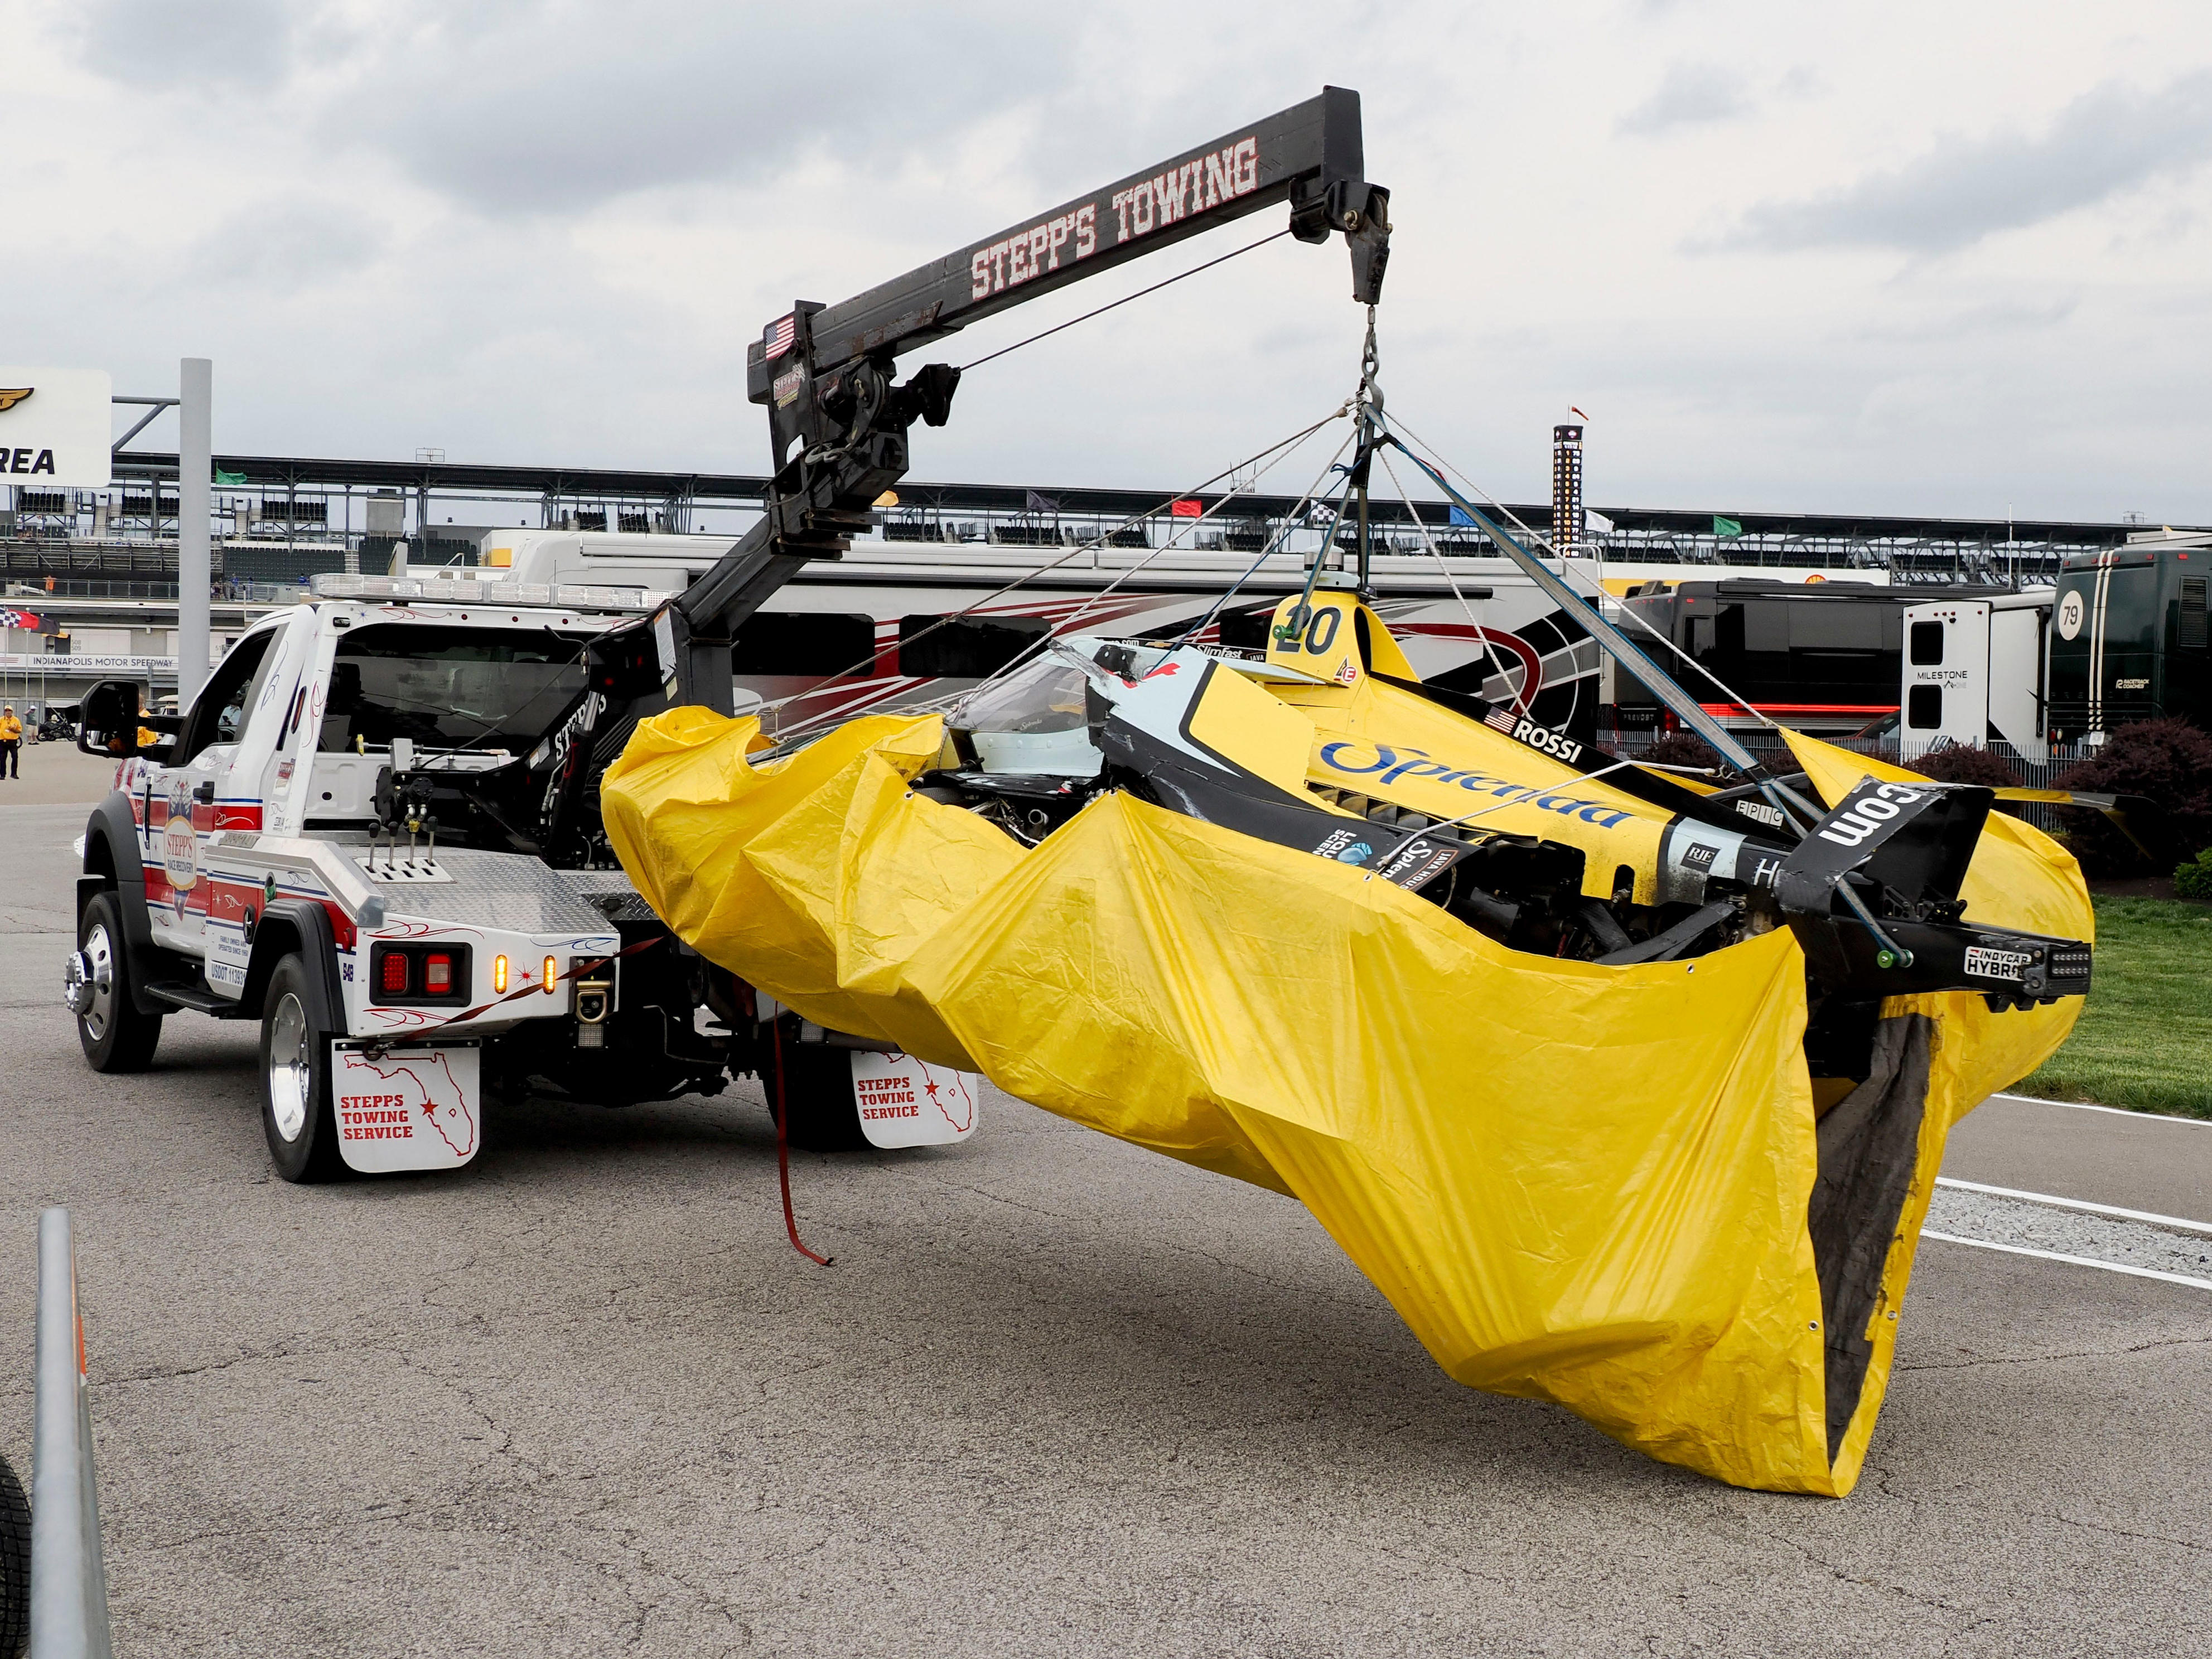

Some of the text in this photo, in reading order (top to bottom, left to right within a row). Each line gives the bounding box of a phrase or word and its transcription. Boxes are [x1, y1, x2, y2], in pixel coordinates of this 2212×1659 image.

[970, 135, 1259, 301] STEPP'S TOWING
[2064, 605, 2078, 626] 79
[1276, 603, 1341, 656] 20
[33, 657, 173, 668] INDIANAPOLIS MOTOR SPEEDWAY
[1917, 670, 1968, 680] MILESTONE
[1513, 719, 1583, 763] ROSSI
[1320, 742, 1637, 829] Splenda
[1737, 802, 1782, 822] EPIC
[1817, 783, 1921, 847] com
[167, 834, 193, 858] STEPP'S
[1426, 853, 1452, 870] JAVA
[1688, 847, 1715, 863] RJE
[167, 859, 194, 874] RACE RECOVERY
[1980, 950, 2029, 964] INDYCAR
[211, 964, 228, 981] USDOT
[857, 1077, 910, 1091] STEPPS
[341, 1095, 404, 1109] STEPPS
[859, 1091, 915, 1105] TOWING
[341, 1110, 408, 1124] TOWING
[862, 1105, 919, 1120] SERVICE
[344, 1126, 413, 1140] SERVICE
